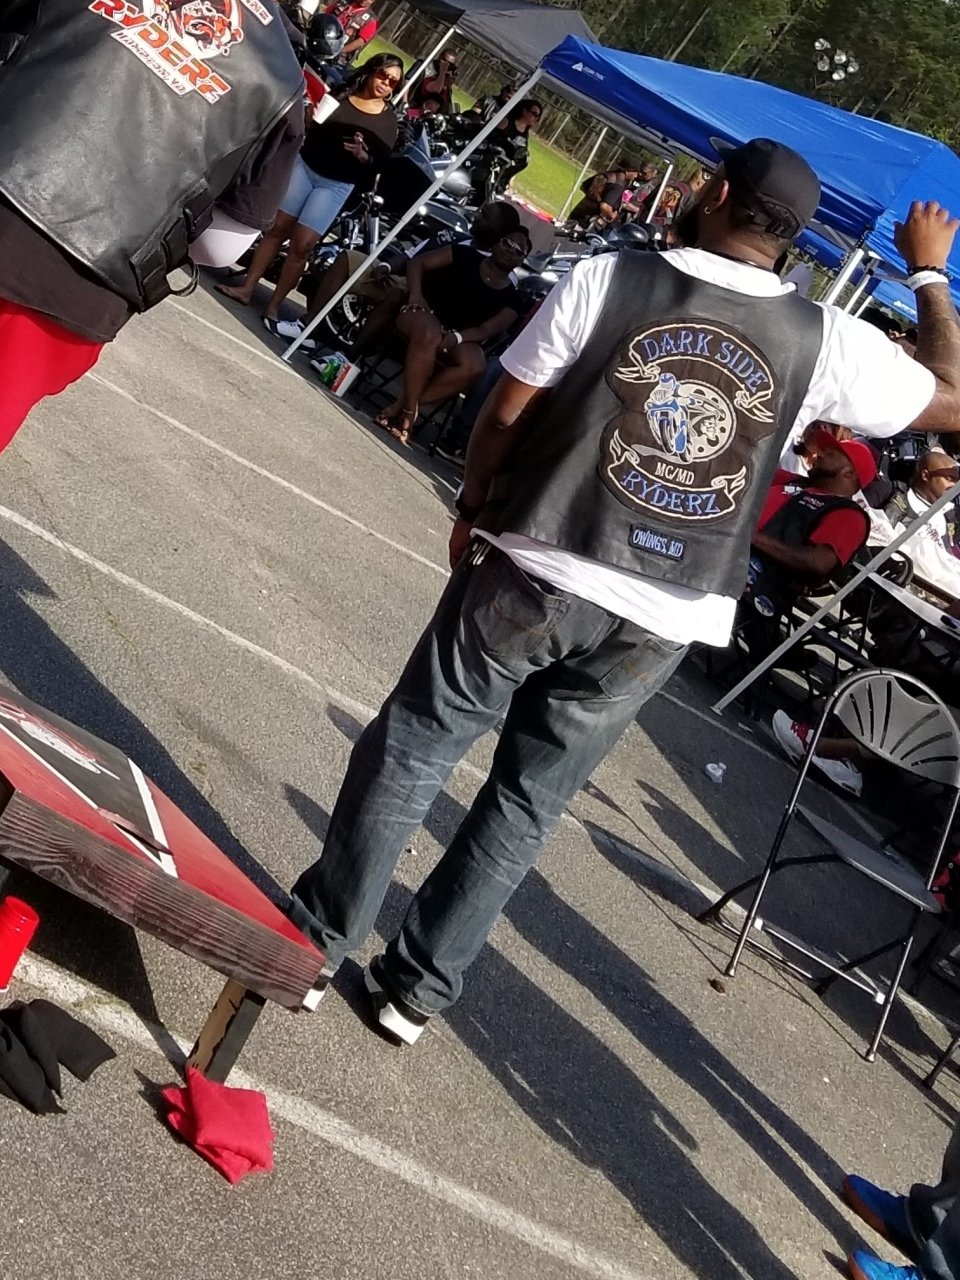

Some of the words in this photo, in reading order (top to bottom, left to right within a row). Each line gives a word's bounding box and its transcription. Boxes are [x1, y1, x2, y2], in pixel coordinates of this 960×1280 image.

[641, 330, 713, 361] DARK
[715, 341, 769, 393] SIDE
[655, 462, 695, 485] MC/MD
[621, 470, 721, 514] RYDERZ
[632, 529, 668, 555] OWINGS,
[668, 540, 684, 557] MD
